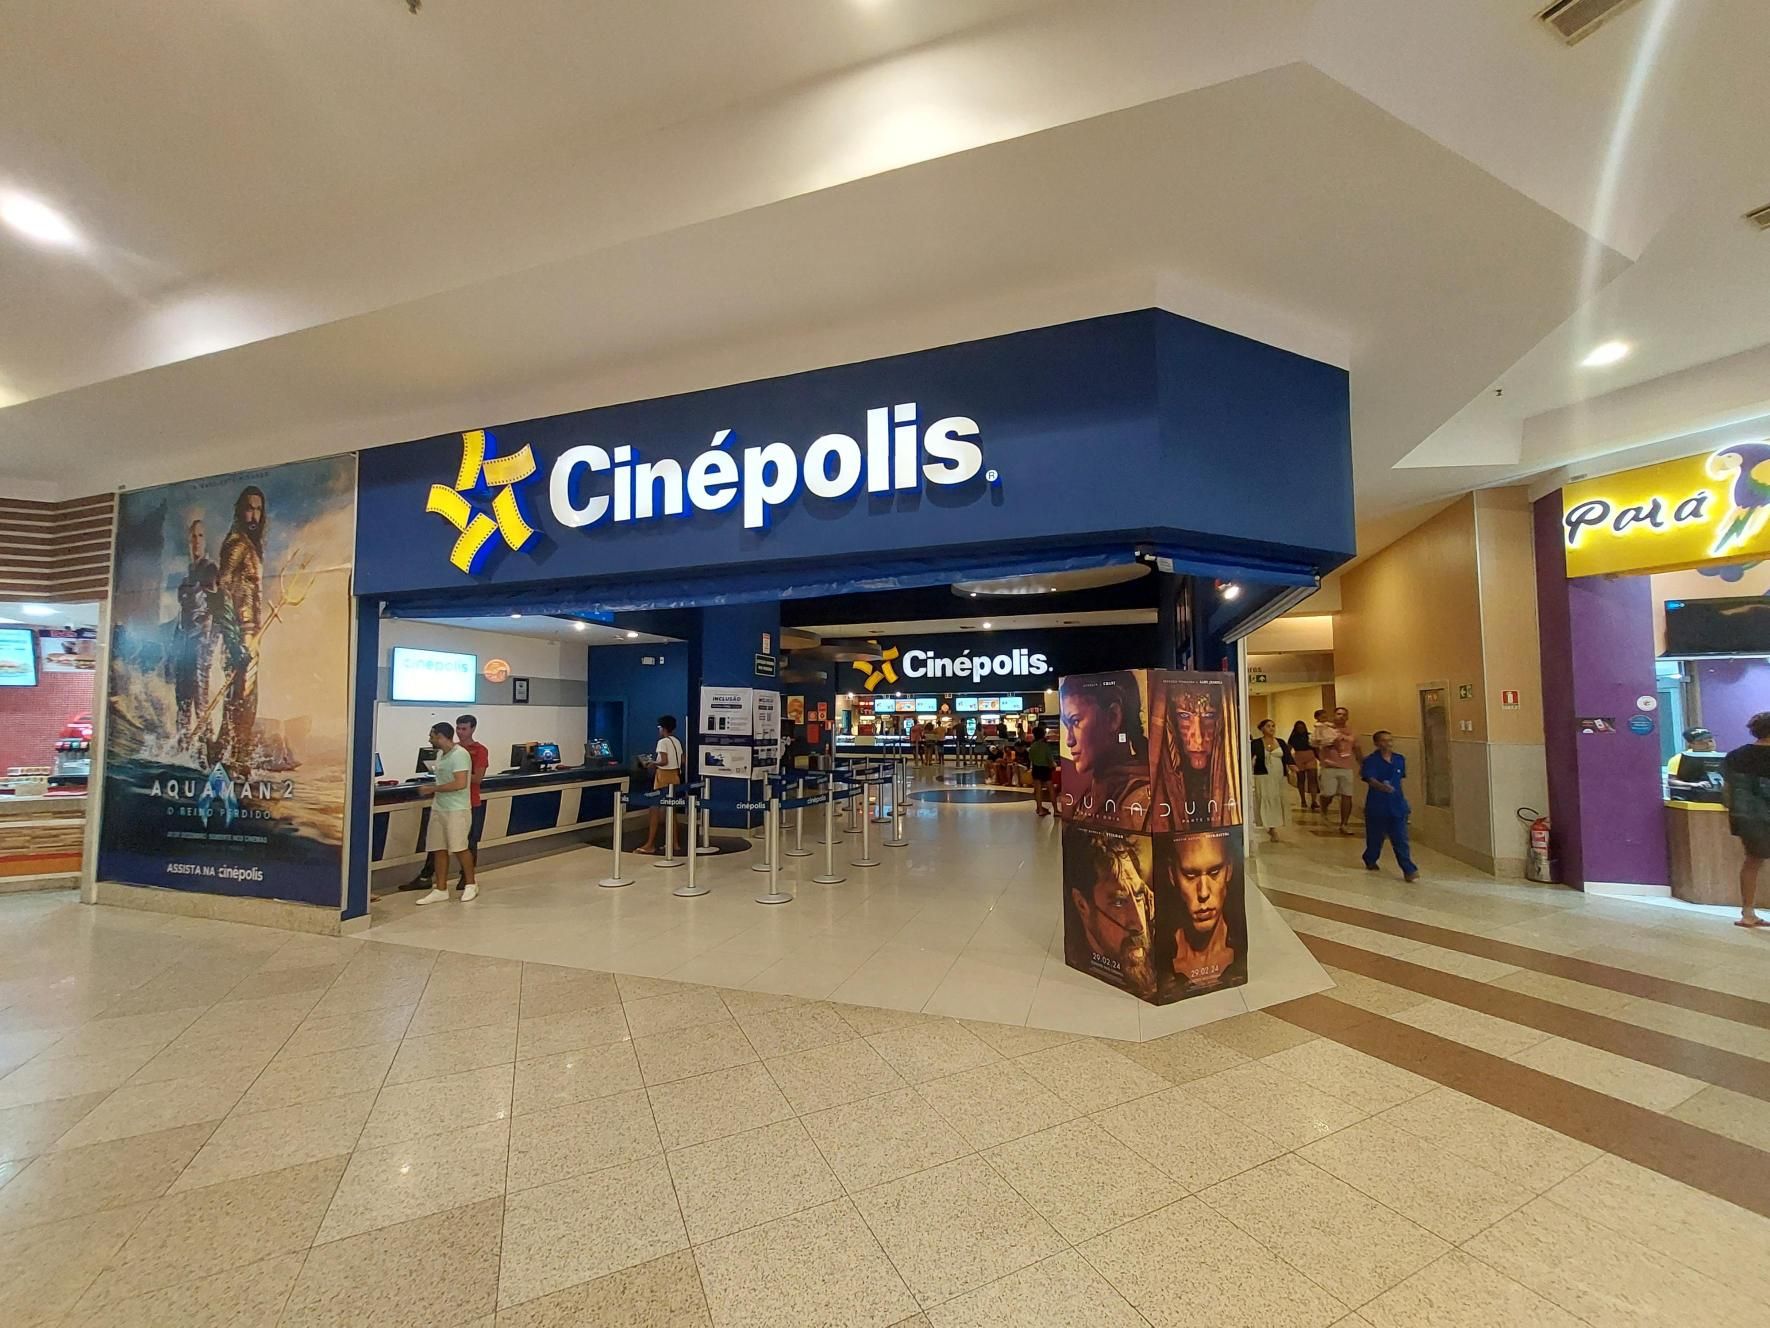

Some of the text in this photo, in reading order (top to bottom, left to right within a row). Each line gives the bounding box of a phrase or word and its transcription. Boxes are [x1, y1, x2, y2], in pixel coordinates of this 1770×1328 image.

[549, 402, 983, 529] Cinépolis
[1565, 491, 1708, 545] Pará
[150, 779, 294, 800] AQUAMAN 2
[167, 863, 264, 882] ASSISTA NA cinépolis
